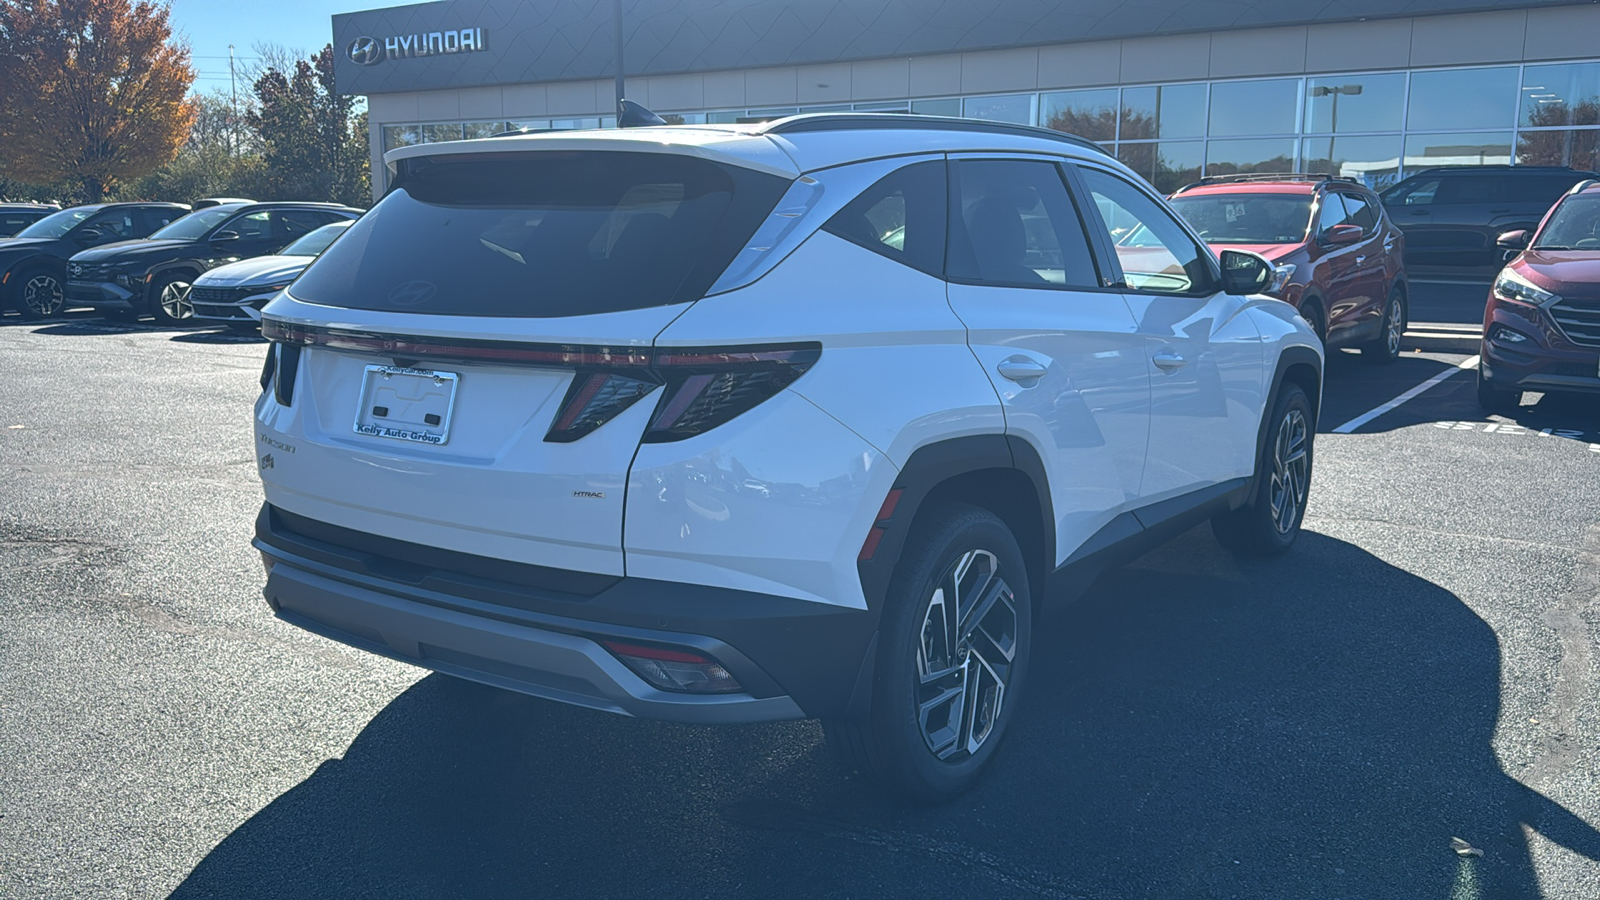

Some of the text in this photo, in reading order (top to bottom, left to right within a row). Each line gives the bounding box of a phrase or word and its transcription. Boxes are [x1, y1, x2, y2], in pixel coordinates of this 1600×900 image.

[384, 27, 482, 59] HYUNDAI
[357, 424, 441, 444] Kelly Auto Group
[573, 490, 603, 498] HTRAC
